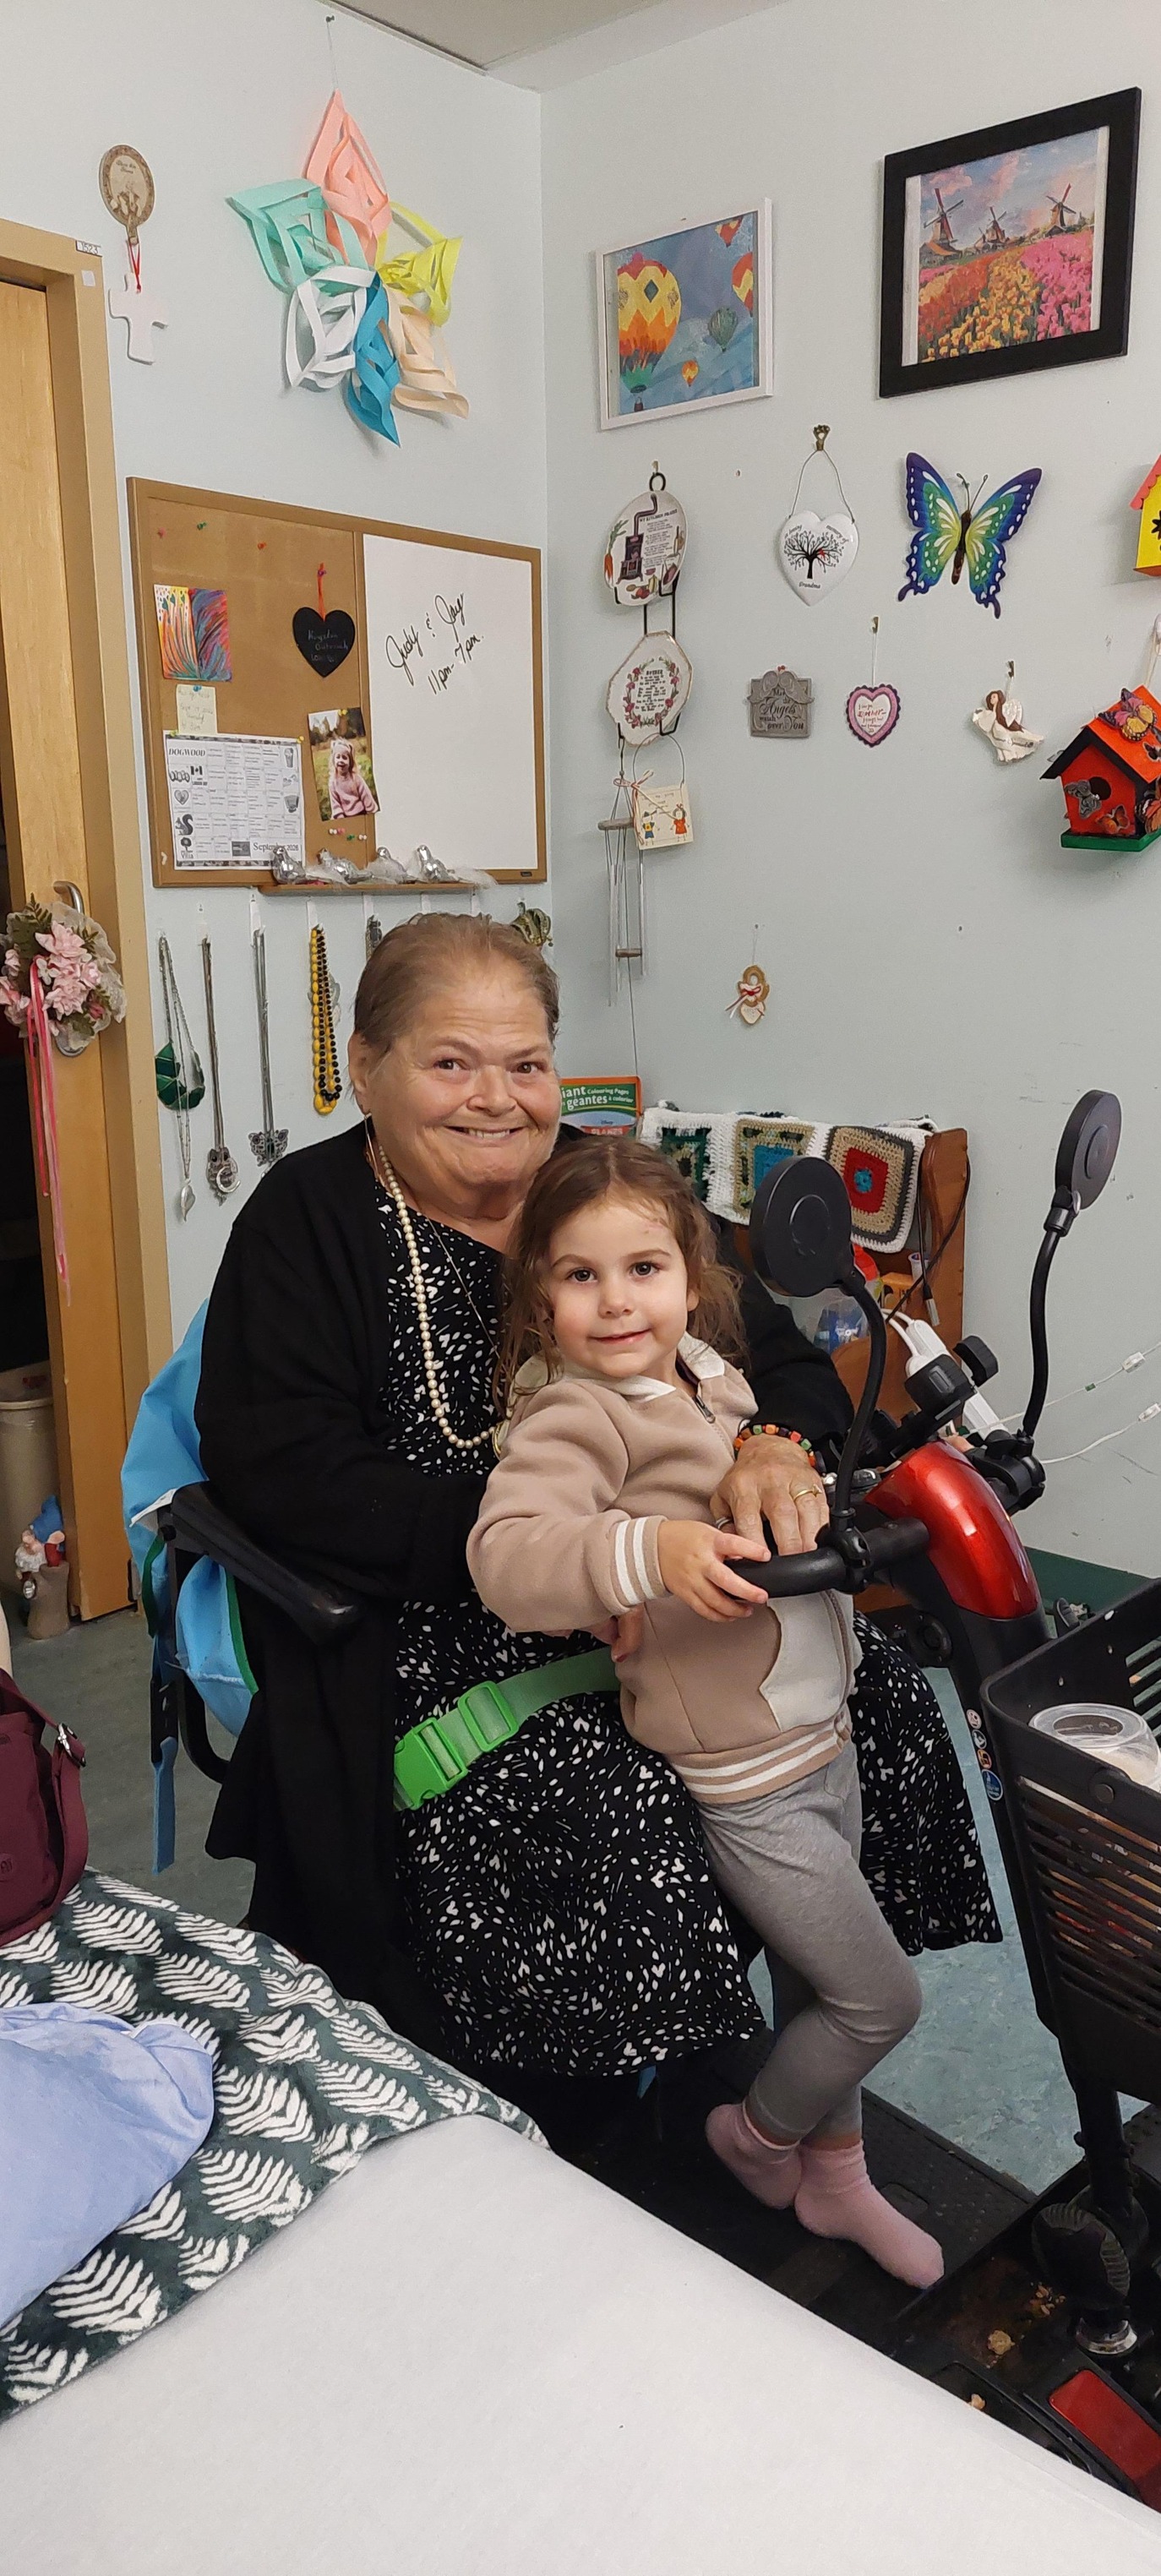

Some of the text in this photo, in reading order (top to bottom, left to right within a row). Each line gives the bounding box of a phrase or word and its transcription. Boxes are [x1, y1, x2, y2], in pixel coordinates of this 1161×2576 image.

[386, 624, 423, 686] Judy
[169, 748, 205, 757] DOGWOOD
[561, 1086, 586, 1098] iant
